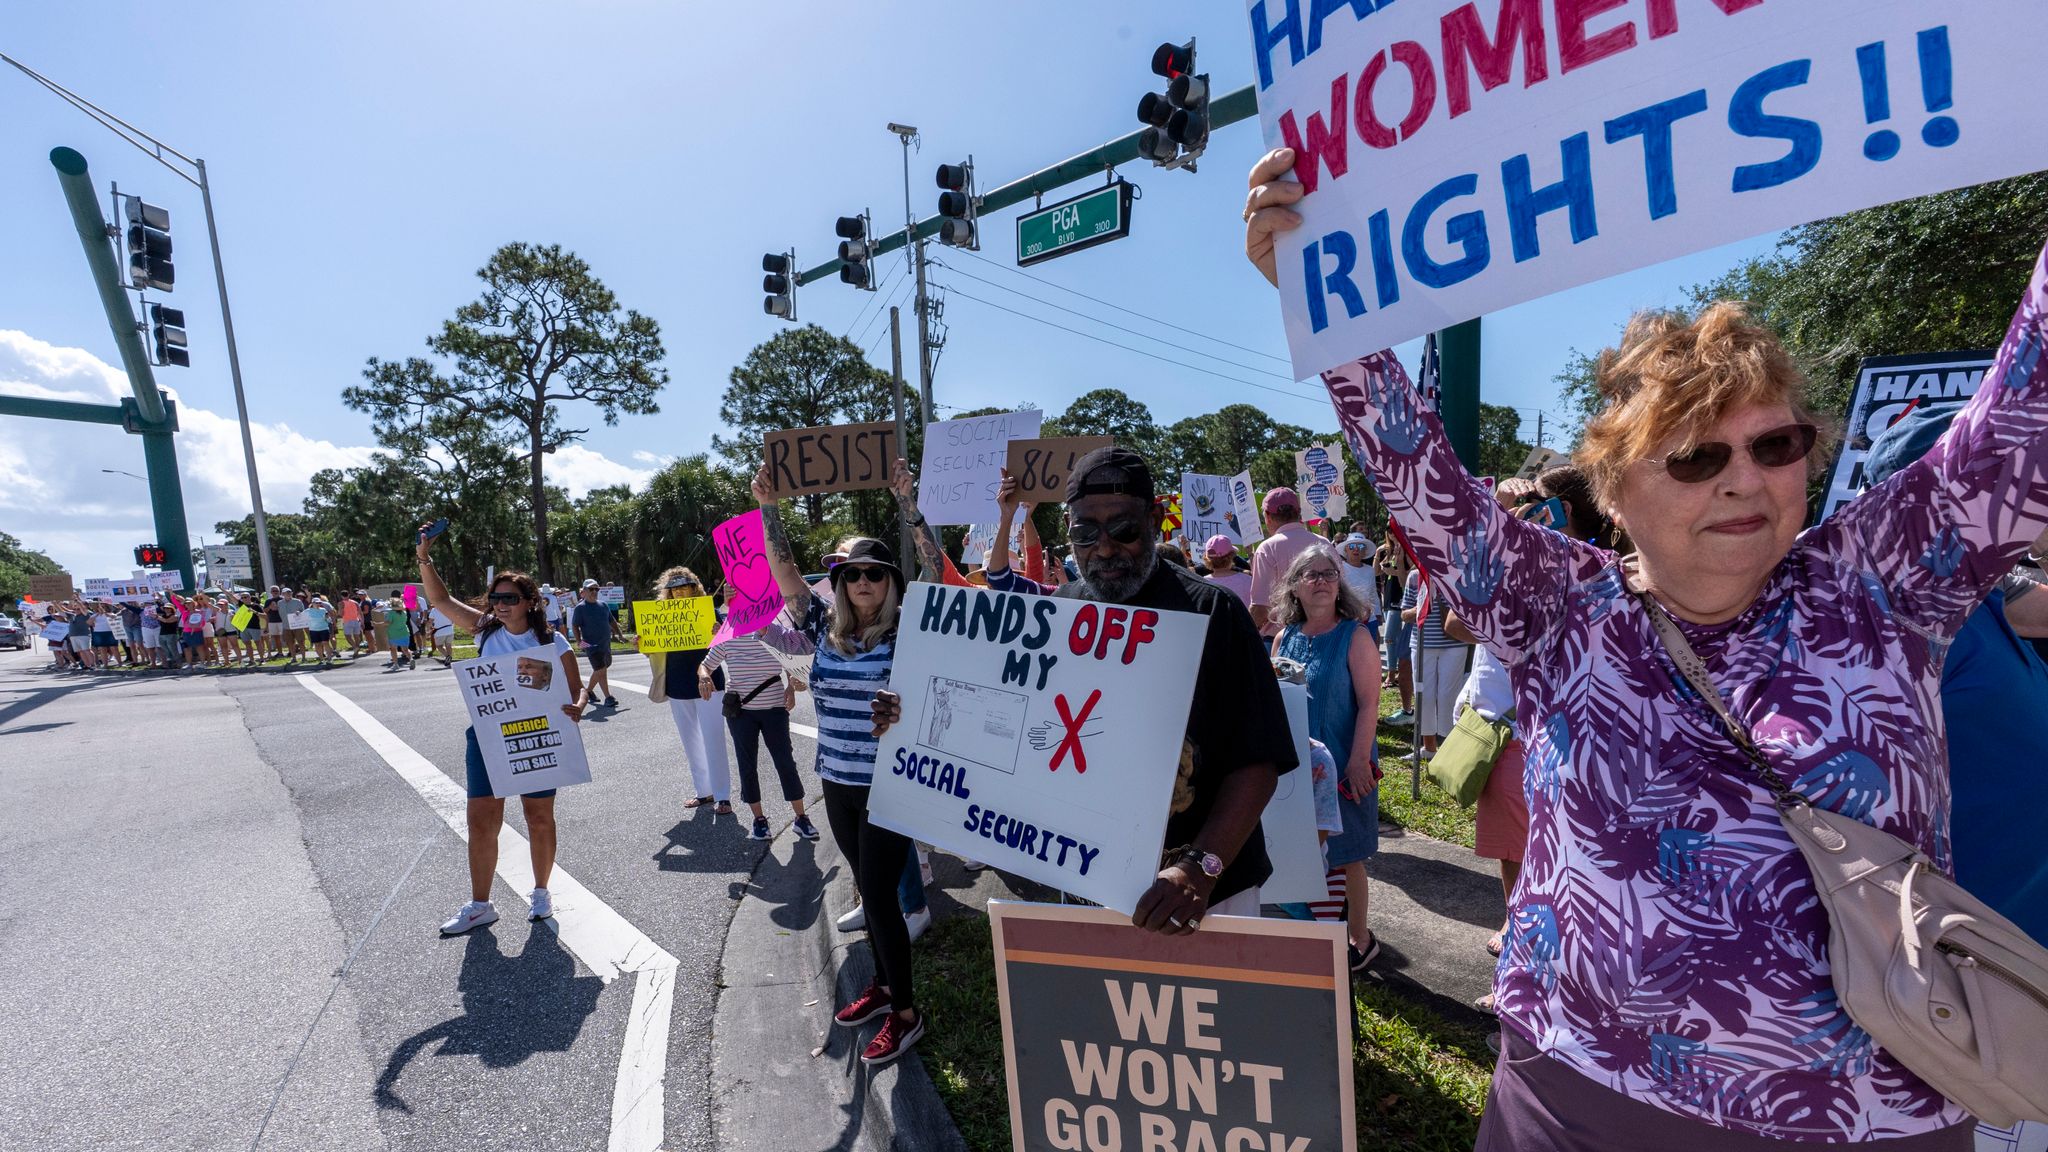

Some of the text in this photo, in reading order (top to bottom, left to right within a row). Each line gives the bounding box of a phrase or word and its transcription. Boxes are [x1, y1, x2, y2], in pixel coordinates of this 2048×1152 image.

[1052, 204, 1080, 234] PGA
[1094, 219, 1110, 233] 3100
[1026, 241, 1042, 255] 3000
[1058, 231, 1075, 245] BLVD
[1873, 370, 1984, 401] HAN
[947, 419, 1019, 447] SOCIAL
[770, 429, 894, 492] RESIST
[932, 450, 1007, 474] SECURIT
[1021, 449, 1060, 491] 86
[926, 481, 975, 505] MUST
[715, 524, 752, 567] WE
[655, 598, 697, 612] SUPPORT
[642, 623, 695, 636] IN AMERICA
[920, 585, 1159, 665] HANDS OFF
[644, 639, 656, 647] AND
[465, 662, 500, 679] TAX
[1001, 649, 1058, 691] MY
[470, 679, 506, 697] THE
[476, 697, 518, 718] RICH
[502, 717, 549, 736] AMERICA
[505, 732, 561, 753] IS NOT FOR
[510, 754, 557, 773] FOR SALE
[892, 747, 970, 800] SOCIAL
[964, 804, 1099, 876] SECURITY
[1104, 979, 1222, 1052] WE
[1060, 1039, 1284, 1124] WON'T
[1044, 1097, 1122, 1152] GO
